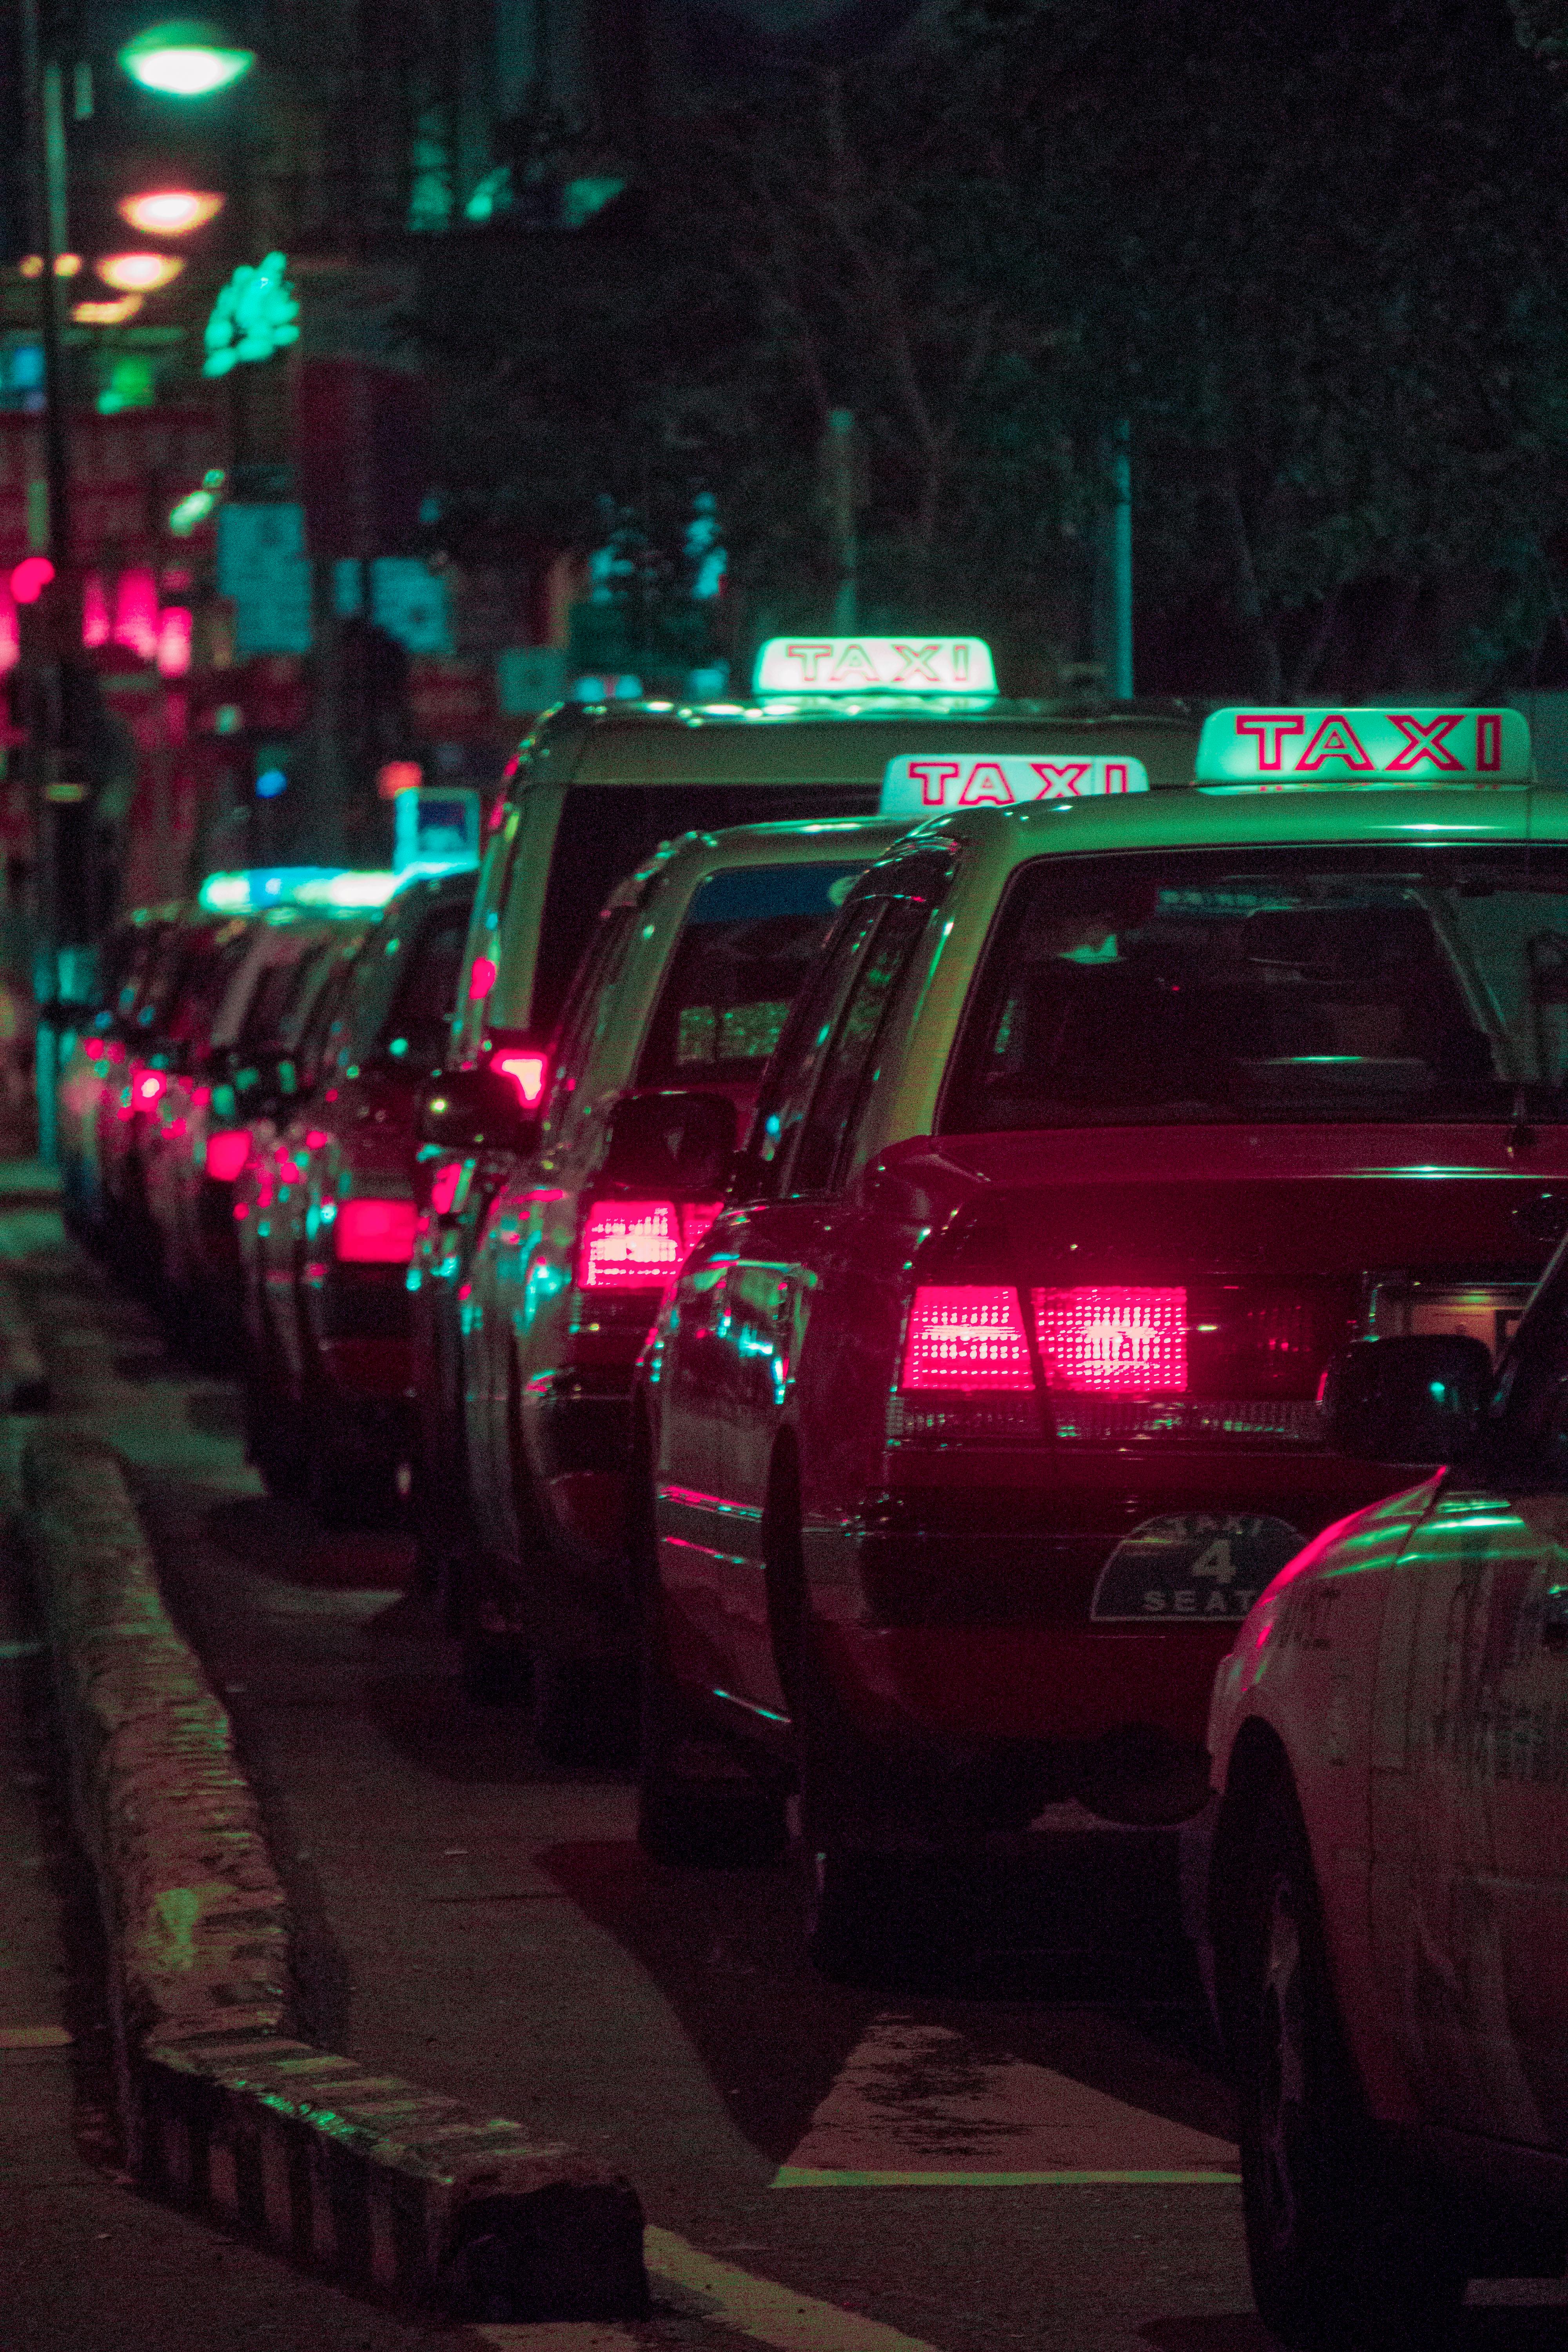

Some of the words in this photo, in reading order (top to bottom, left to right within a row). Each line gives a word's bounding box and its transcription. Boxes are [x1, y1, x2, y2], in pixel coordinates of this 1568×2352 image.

[787, 644, 970, 682] TAXI
[1236, 715, 1503, 771] TAXI
[908, 762, 1128, 806] TAXI
[1190, 1538, 1238, 1584] 4
